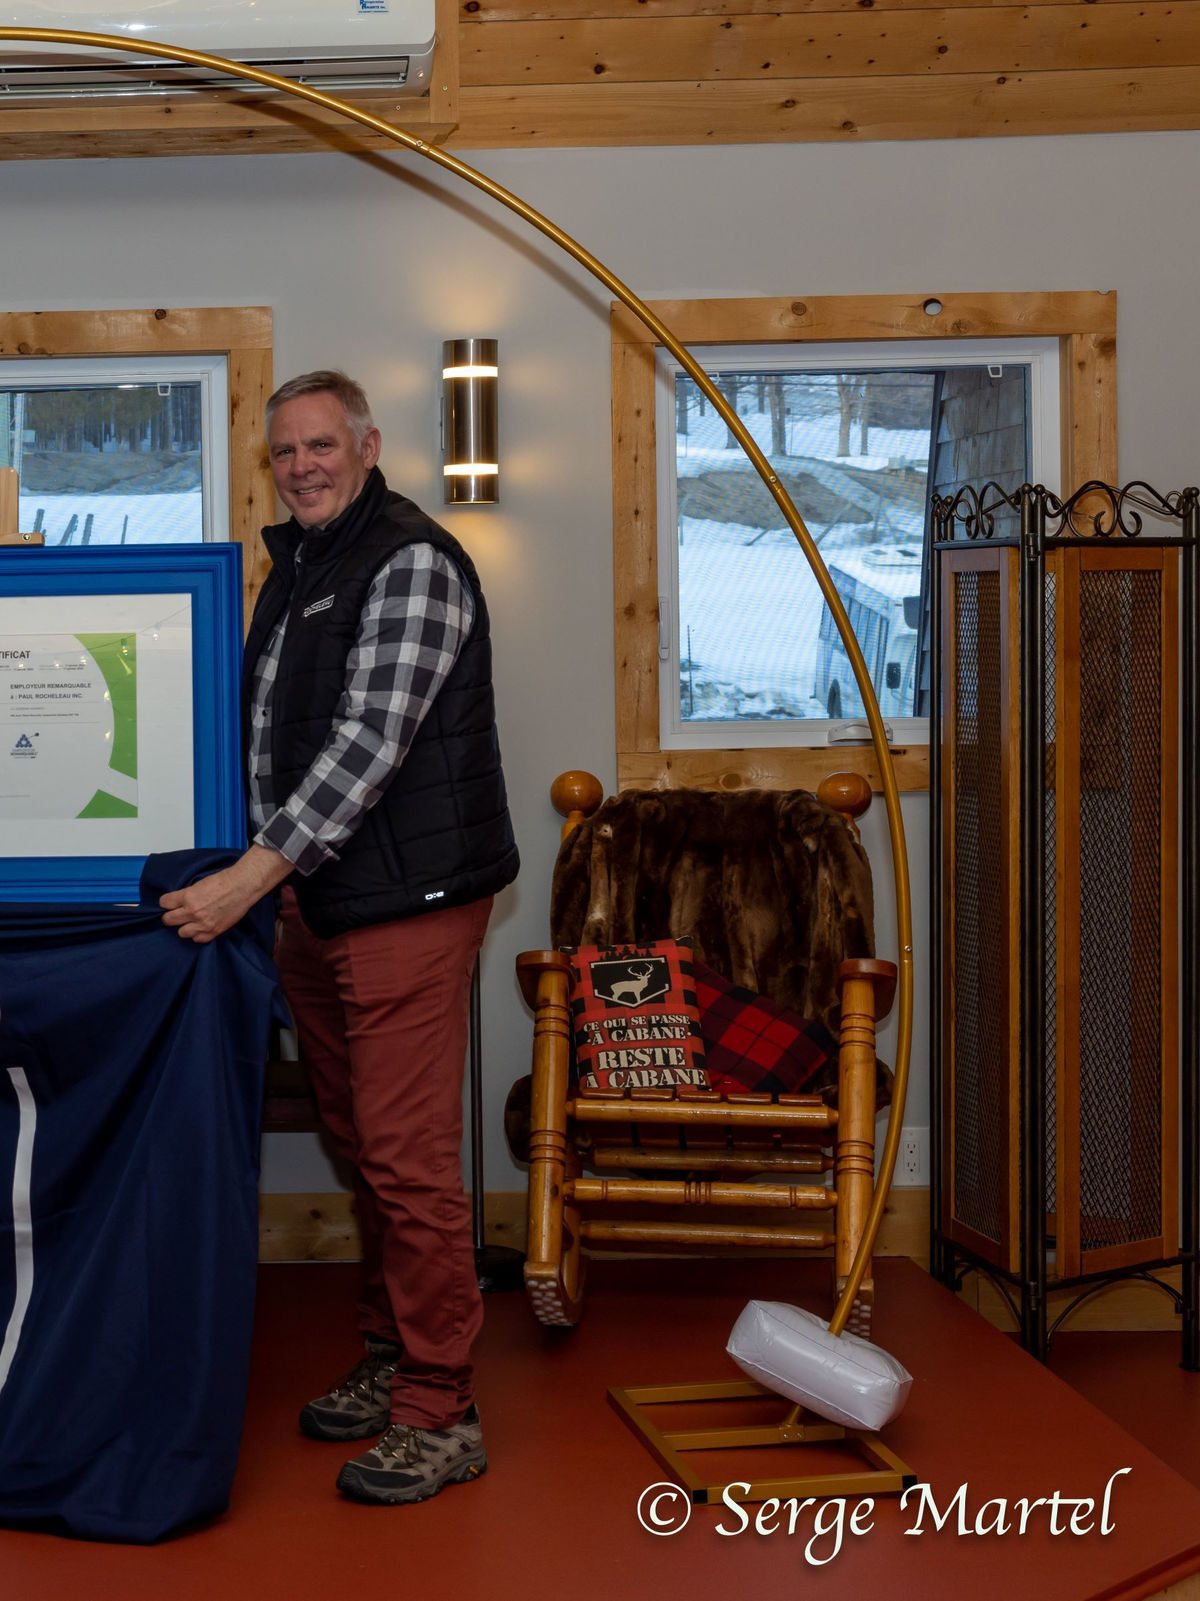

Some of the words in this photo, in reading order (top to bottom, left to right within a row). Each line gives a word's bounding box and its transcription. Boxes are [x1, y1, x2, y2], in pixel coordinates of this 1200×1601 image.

[583, 1021, 600, 1033] CE
[603, 1018, 626, 1029] QUI
[631, 1015, 647, 1026] SE
[650, 1014, 691, 1025] PASSE
[598, 1047, 686, 1070] RESTE
[608, 1068, 706, 1089] CABANE
